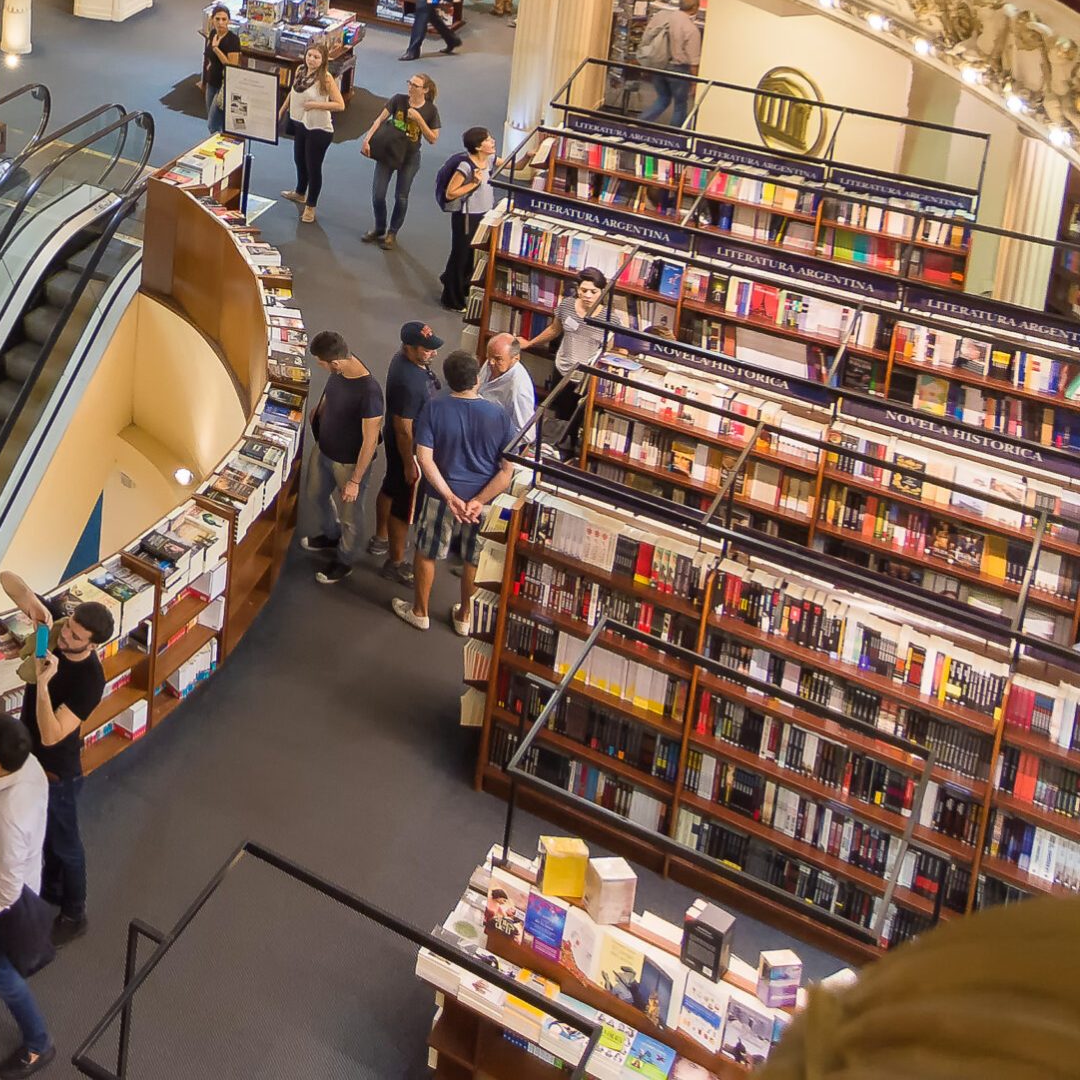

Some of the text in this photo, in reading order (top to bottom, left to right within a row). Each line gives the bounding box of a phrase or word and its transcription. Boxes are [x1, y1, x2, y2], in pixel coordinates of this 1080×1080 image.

[574, 120, 681, 148] LITERATURA ARGENTINA
[703, 148, 817, 179] LITERATURA ARGENTINA
[840, 177, 964, 208] LITERATURA ARGENTINA
[530, 198, 671, 242] LITERATURA ARGENTINA
[716, 246, 875, 293] LITERATURA ARGENTINA
[926, 298, 1080, 343] LITERATURA ARGENT
[653, 343, 790, 390] NOVELA HISTORICA
[885, 410, 1043, 463] NOVELA HISTORICA
